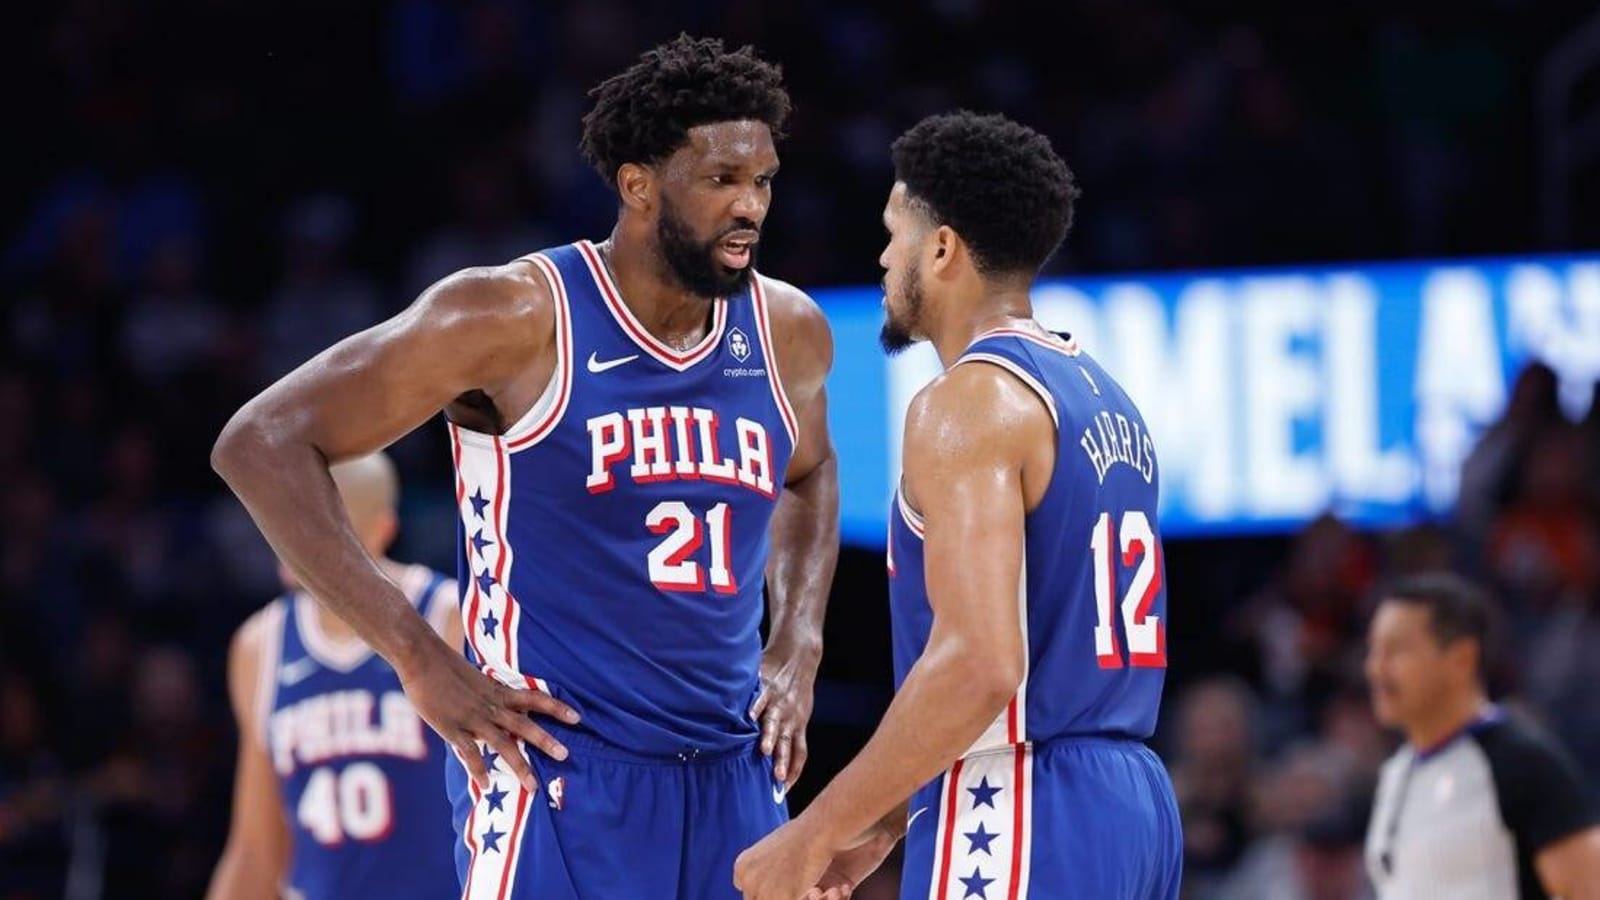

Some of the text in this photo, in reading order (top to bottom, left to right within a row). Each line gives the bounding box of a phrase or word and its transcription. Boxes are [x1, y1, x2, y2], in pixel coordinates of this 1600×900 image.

[723, 367, 766, 378] crypto.com
[586, 405, 775, 500] PHILA
[1080, 411, 1154, 485] HARRIS
[645, 501, 738, 594] 21
[1090, 511, 1167, 669] 12
[270, 688, 427, 776] PHILA
[297, 761, 392, 847] 40
